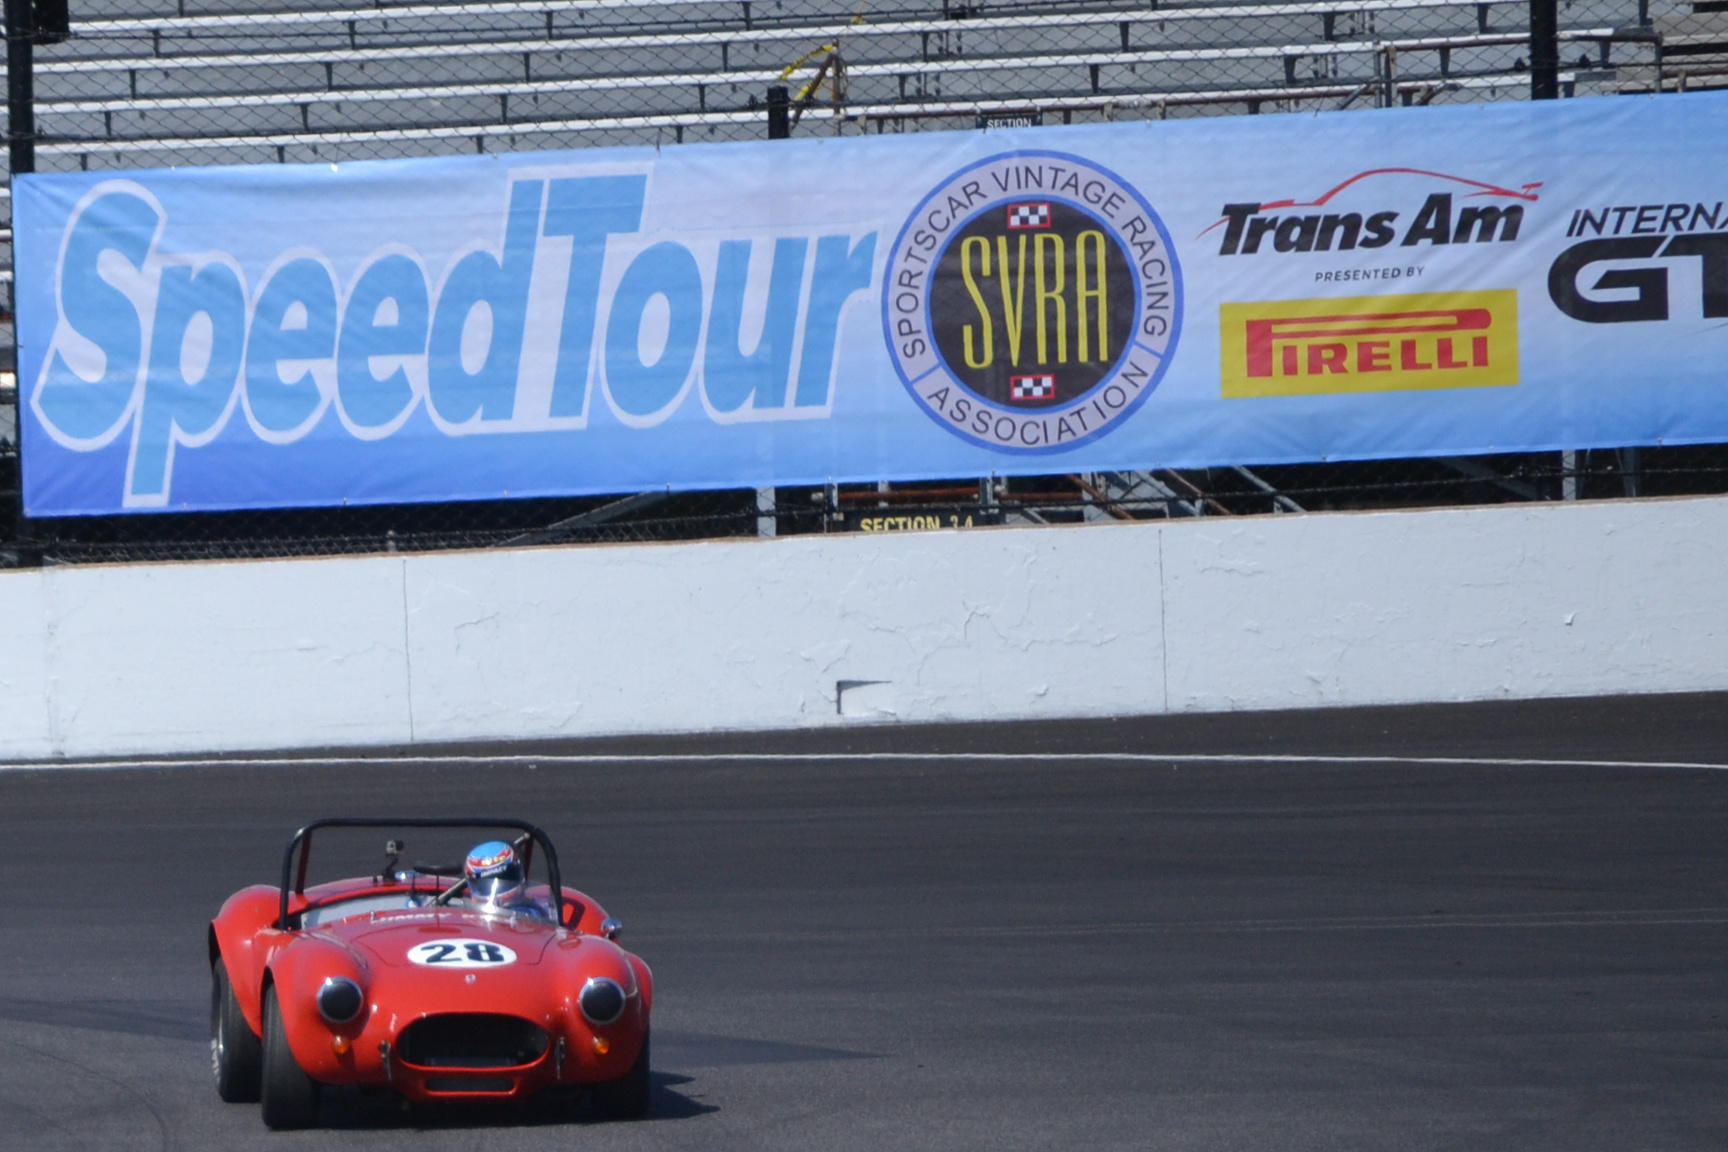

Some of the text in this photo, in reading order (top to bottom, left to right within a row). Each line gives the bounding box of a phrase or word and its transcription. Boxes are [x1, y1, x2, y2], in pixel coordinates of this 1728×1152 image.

[987, 117, 1032, 129] SECTION
[1218, 192, 1525, 256] Trans Am
[895, 165, 1170, 359] SPORTSCAR VINTAGE RACING
[1315, 266, 1425, 282] PRESENTED BY
[960, 229, 1109, 369] SVRA
[34, 164, 879, 505] SpeedTour
[1245, 308, 1492, 378] PIRELLI
[926, 361, 1149, 446] ASSOCIATION
[860, 516, 941, 531] SECTION
[420, 943, 505, 963] 28
